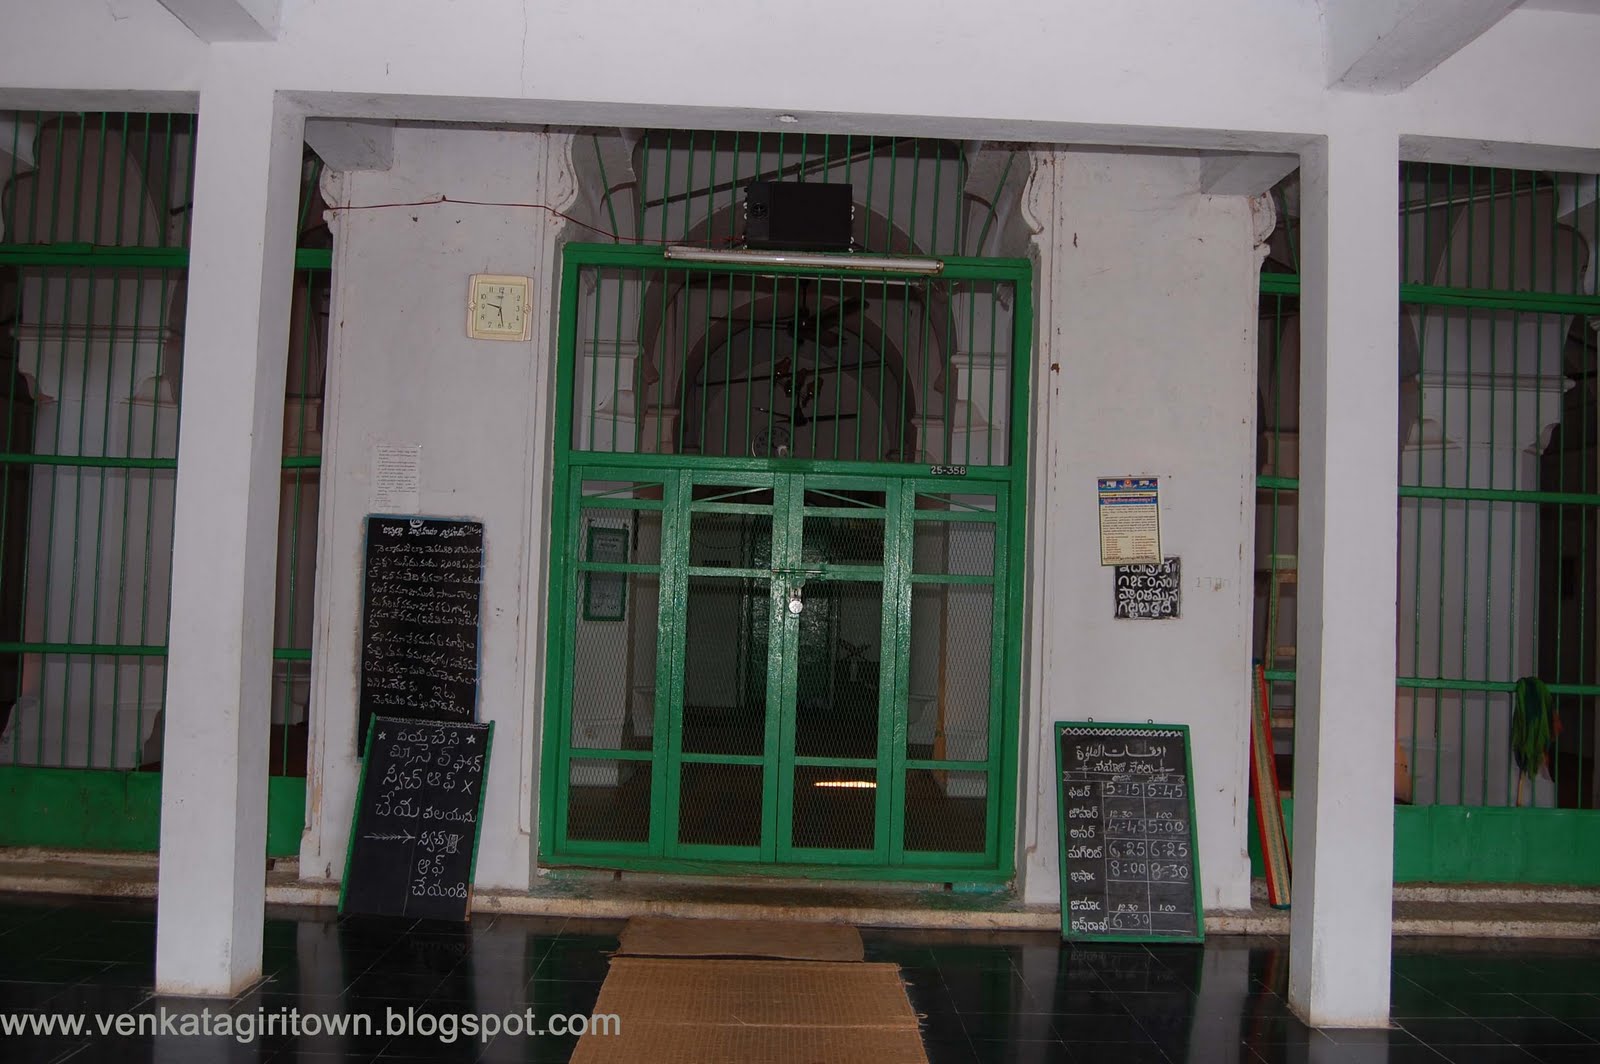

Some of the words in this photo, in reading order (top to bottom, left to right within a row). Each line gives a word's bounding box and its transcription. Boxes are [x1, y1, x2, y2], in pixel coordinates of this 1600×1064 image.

[931, 466, 966, 475] 25-358
[441, 560, 460, 568] 2008
[1106, 782, 1140, 794] 5:15
[1147, 784, 1183, 798] 5:45
[1109, 841, 1145, 857] 6:25
[1150, 841, 1187, 857] 6:25
